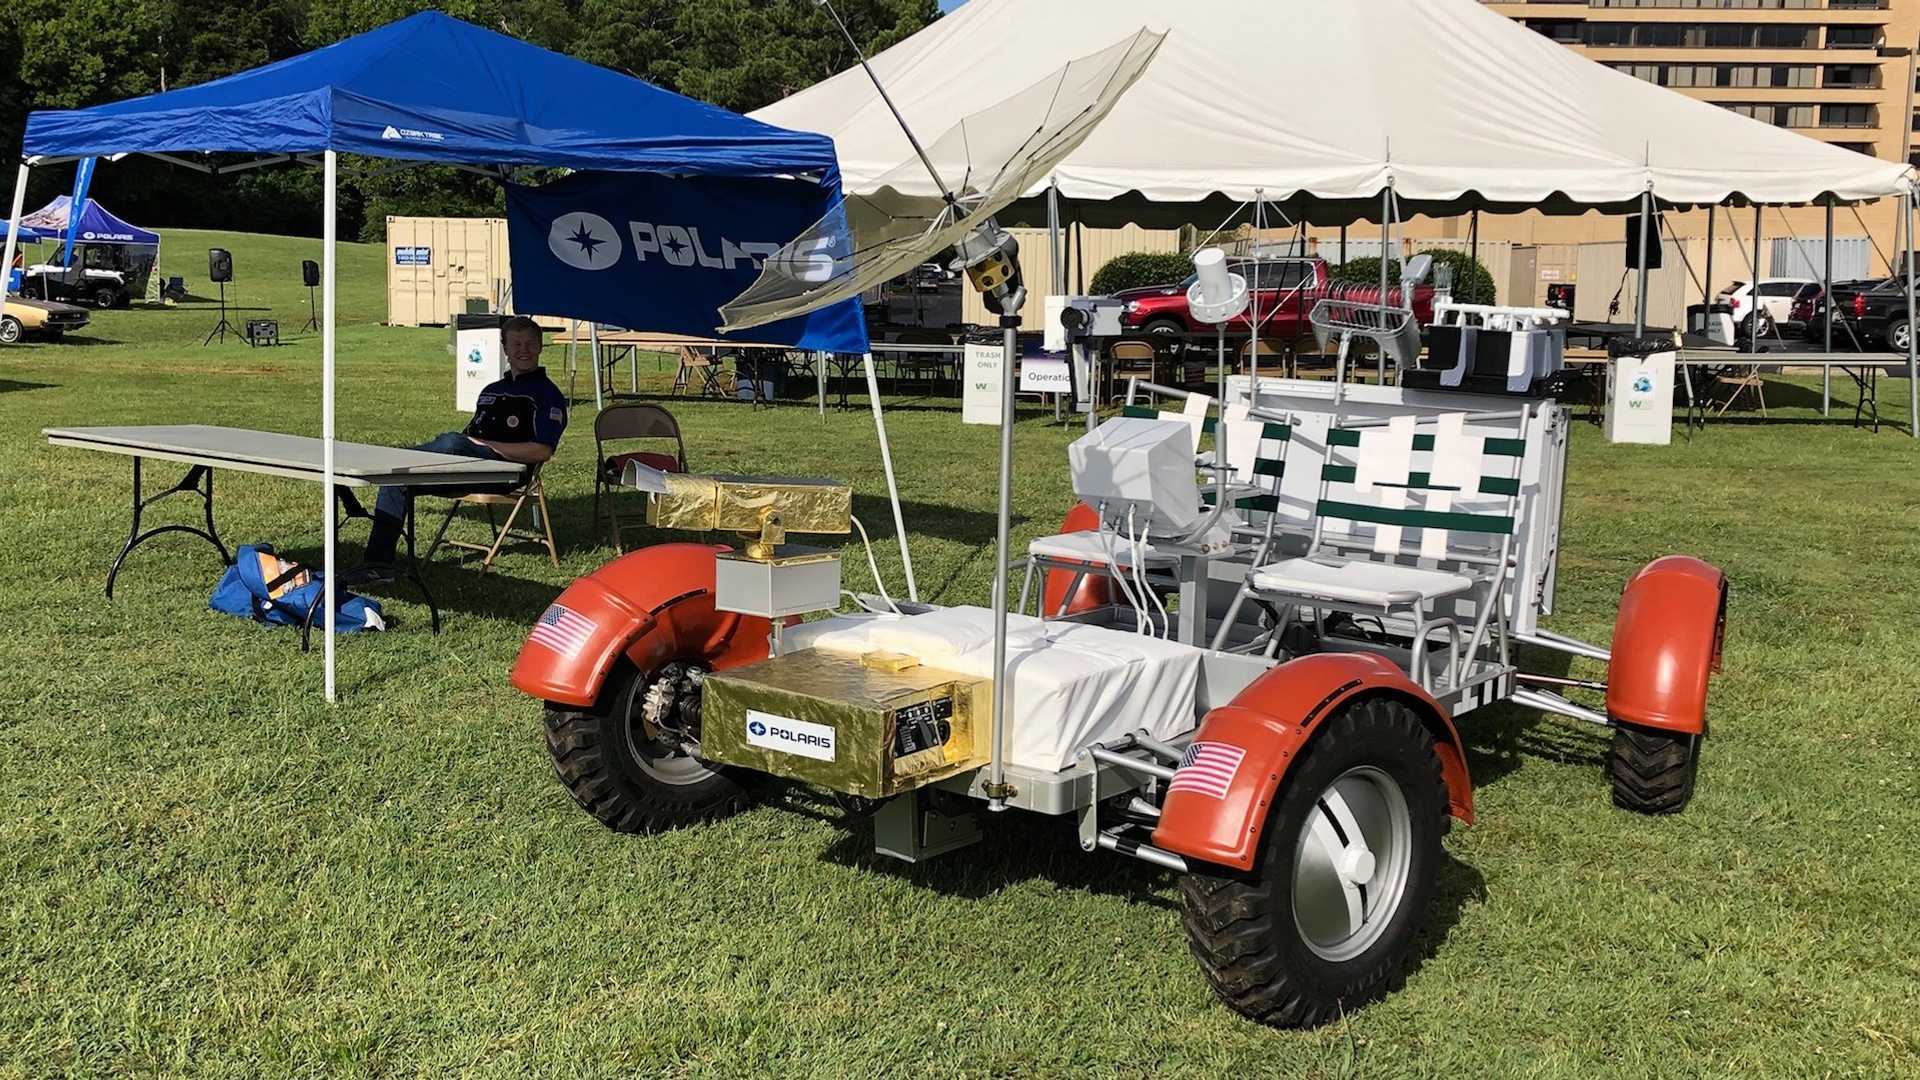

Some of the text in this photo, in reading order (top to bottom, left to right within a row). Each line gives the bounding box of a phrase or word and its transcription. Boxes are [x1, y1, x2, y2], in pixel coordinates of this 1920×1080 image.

[96, 233, 134, 241] POLARIS
[628, 220, 834, 283] POLARIS
[975, 351, 1001, 359] TRASH
[976, 361, 998, 369] ONLY
[770, 727, 831, 749] POLARIS
